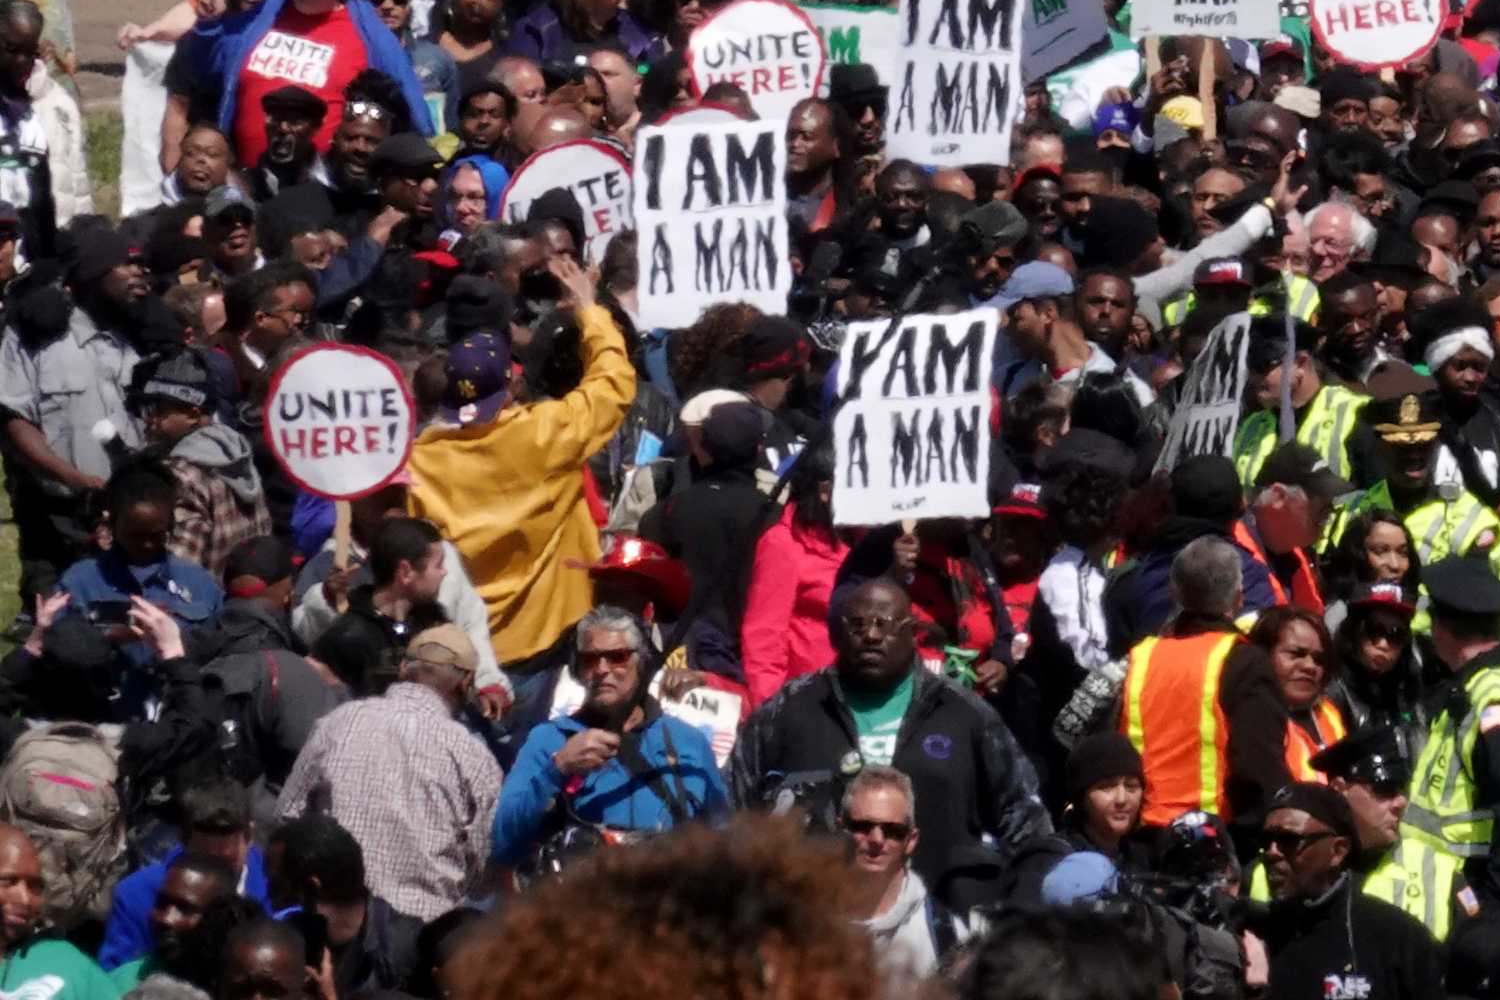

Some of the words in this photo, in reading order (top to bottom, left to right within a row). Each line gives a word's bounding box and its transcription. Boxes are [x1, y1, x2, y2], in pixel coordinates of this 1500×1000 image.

[264, 31, 333, 60] UNITE
[703, 33, 812, 66] UNITE
[894, 60, 916, 132] A
[930, 61, 1011, 136] MAN
[645, 134, 664, 209] I
[685, 131, 773, 203] AM
[648, 222, 673, 295] A
[694, 218, 779, 294] MAN
[885, 319, 985, 398] AM
[279, 388, 400, 422] UNITE
[280, 422, 397, 458] HERE!
[846, 412, 869, 489] A
[891, 407, 980, 489] MAN
